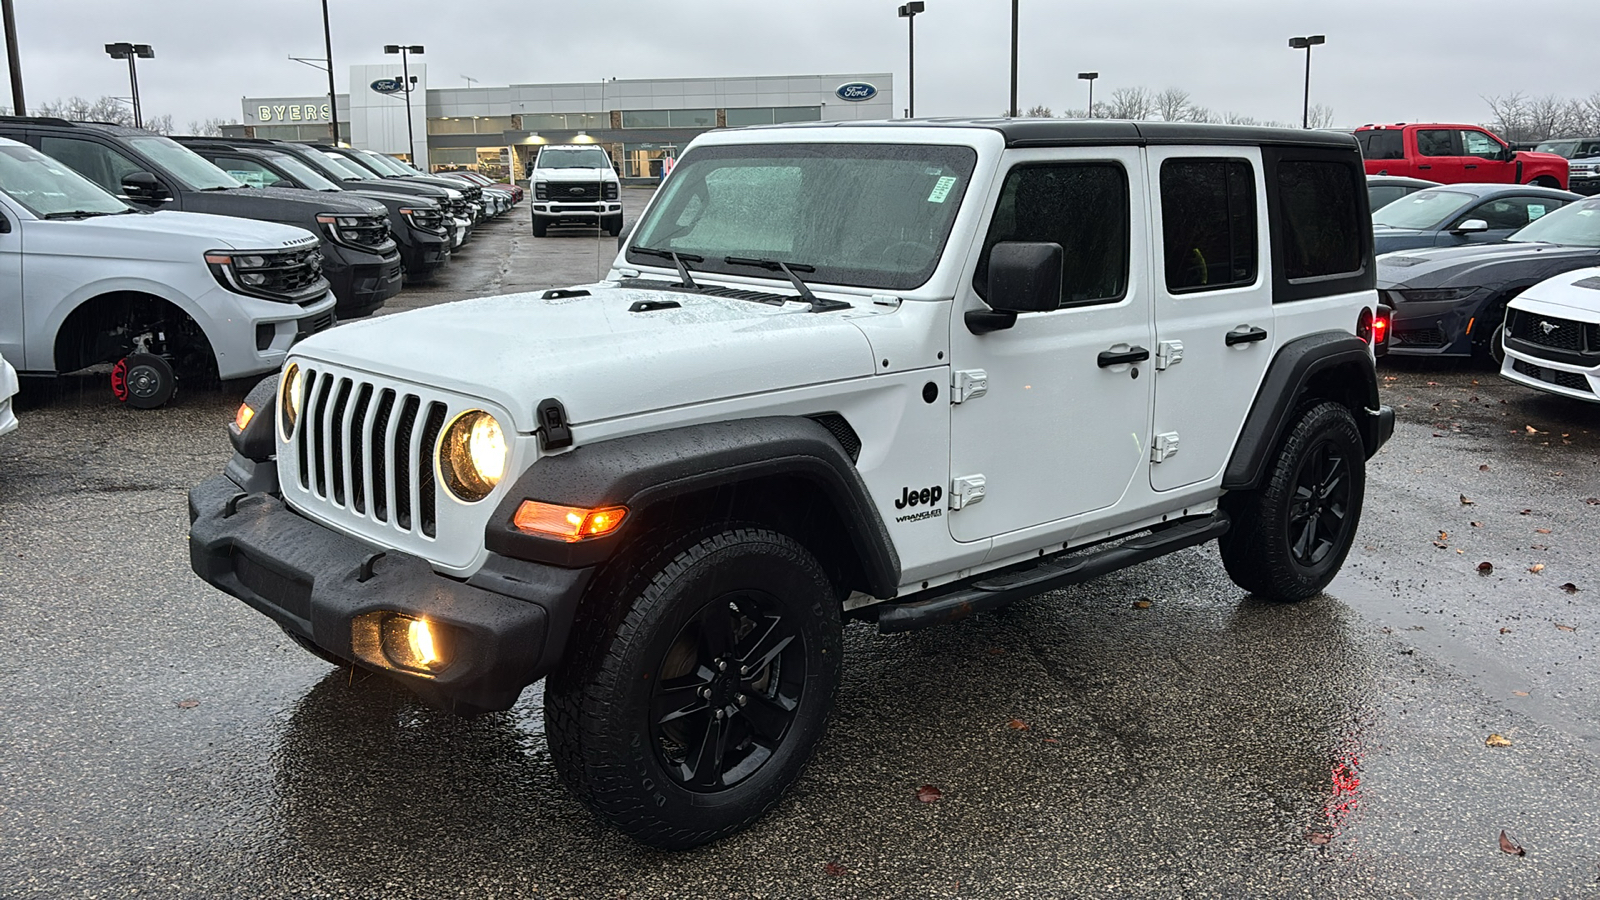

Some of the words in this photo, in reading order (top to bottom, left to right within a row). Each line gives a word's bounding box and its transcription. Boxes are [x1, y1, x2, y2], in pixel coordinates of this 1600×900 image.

[844, 86, 869, 97] Ford
[258, 104, 329, 121] BYERS
[895, 485, 942, 510] Jeep
[895, 508, 942, 523] WRANGLER
